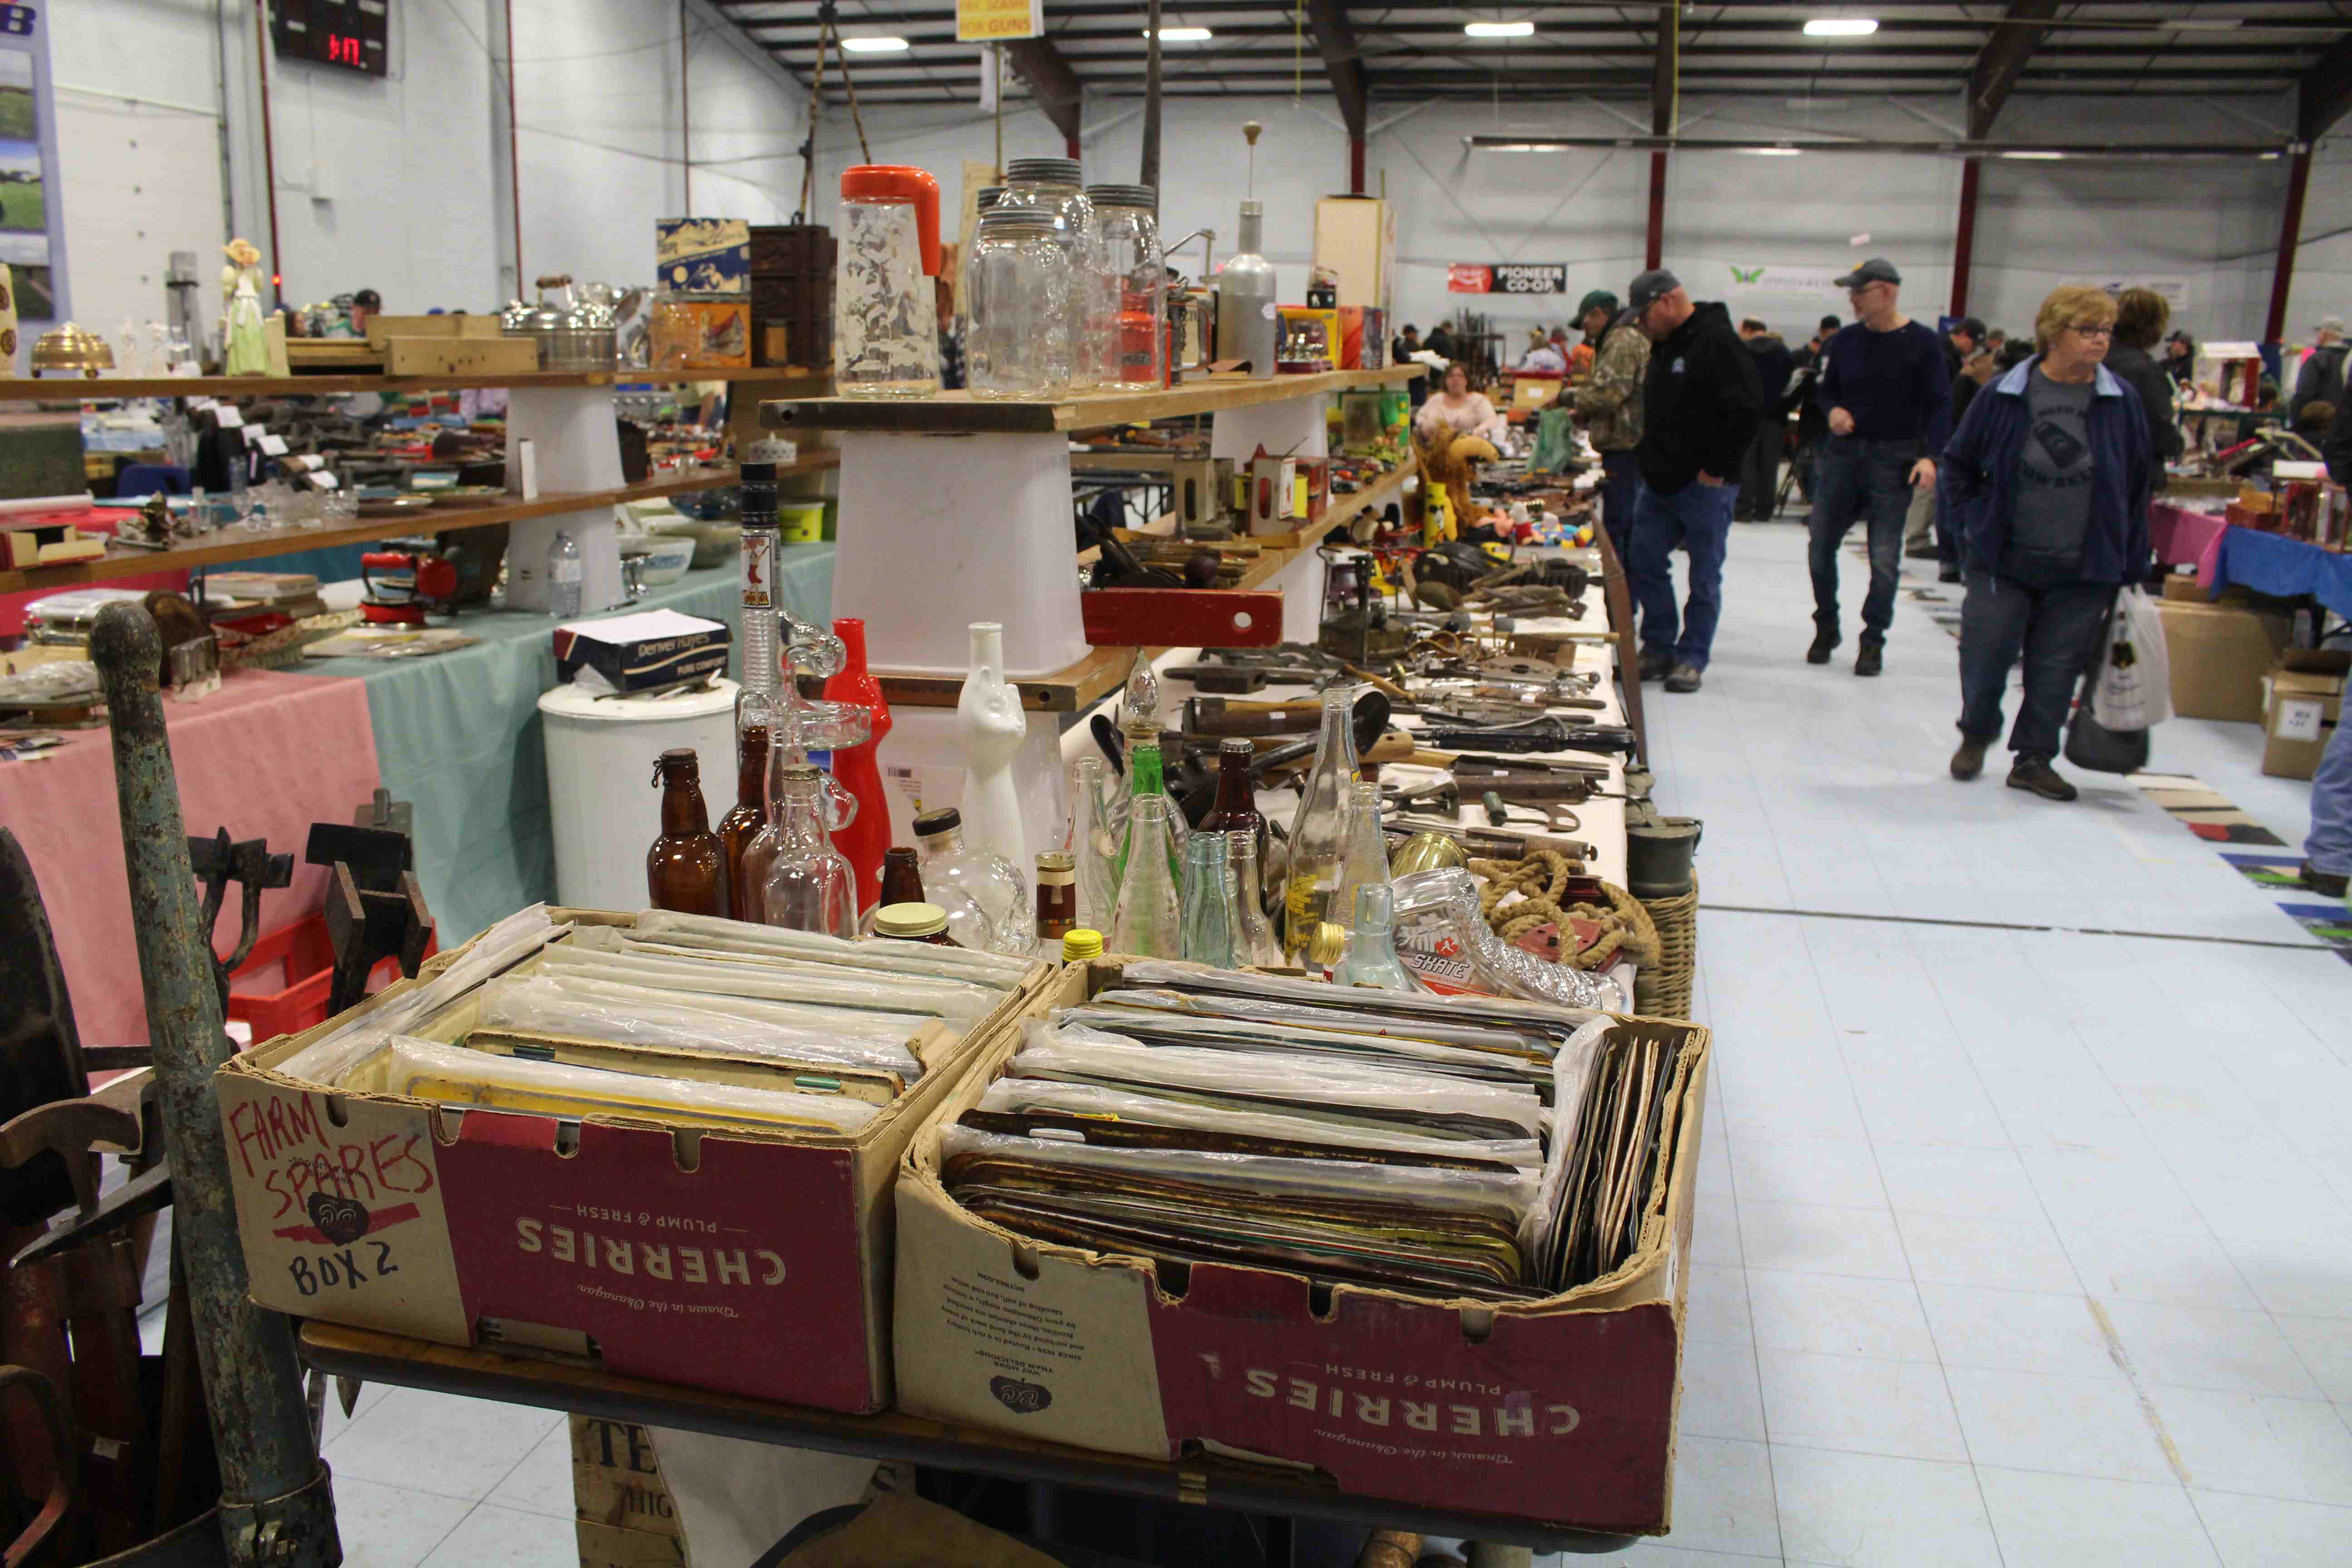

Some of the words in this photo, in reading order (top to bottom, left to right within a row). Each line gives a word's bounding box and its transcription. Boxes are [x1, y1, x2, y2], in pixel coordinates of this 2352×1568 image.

[989, 18, 1031, 32] GUNS
[1498, 266, 1563, 280] PIONEER
[639, 639, 675, 657] Denver
[1411, 953, 1469, 979] SKATE
[229, 1092, 330, 1178] FARM
[265, 1134, 434, 1219] SPARES
[577, 1204, 632, 1224] FRESH
[638, 1212, 650, 1225] &
[656, 1216, 717, 1234] PLUMP
[515, 1216, 787, 1286] CHERRIES
[289, 1249, 368, 1296] BOX
[366, 1240, 398, 1276] 2
[943, 1283, 967, 1298] natural
[971, 1285, 985, 1294] and
[986, 1290, 1000, 1299] sun
[577, 1284, 645, 1310] Okanagan
[648, 1300, 667, 1312] the
[671, 1304, 684, 1313] in
[687, 1305, 739, 1318] Grown
[941, 1305, 959, 1317] many
[946, 1297, 973, 1313] touched
[1029, 1303, 1063, 1316] blending
[988, 1313, 1017, 1326] cherries
[1003, 1307, 1043, 1322] Okanagan
[946, 1318, 970, 1333] history
[970, 1318, 988, 1328] work
[990, 1324, 1006, 1334] hard
[1019, 1322, 1039, 1331] these
[1066, 1321, 1076, 1330] by
[972, 1328, 986, 1338] rich
[1008, 1329, 1020, 1338] the
[1041, 1326, 1073, 1339] families,
[1004, 1339, 1030, 1351] Rooted
[1034, 1336, 1068, 1347] nurtured
[994, 1361, 1019, 1371] MORE
[1022, 1367, 1041, 1376] WAY
[1028, 1363, 1054, 1373] THAN
[1325, 1363, 1394, 1383] FRESH
[1403, 1375, 1419, 1387] &
[1425, 1379, 1501, 1396] PLUMP
[1245, 1367, 1581, 1437] CHERRIES
[1314, 1428, 1397, 1455] Okanagan
[1402, 1448, 1426, 1460] the
[1431, 1450, 1446, 1459] in
